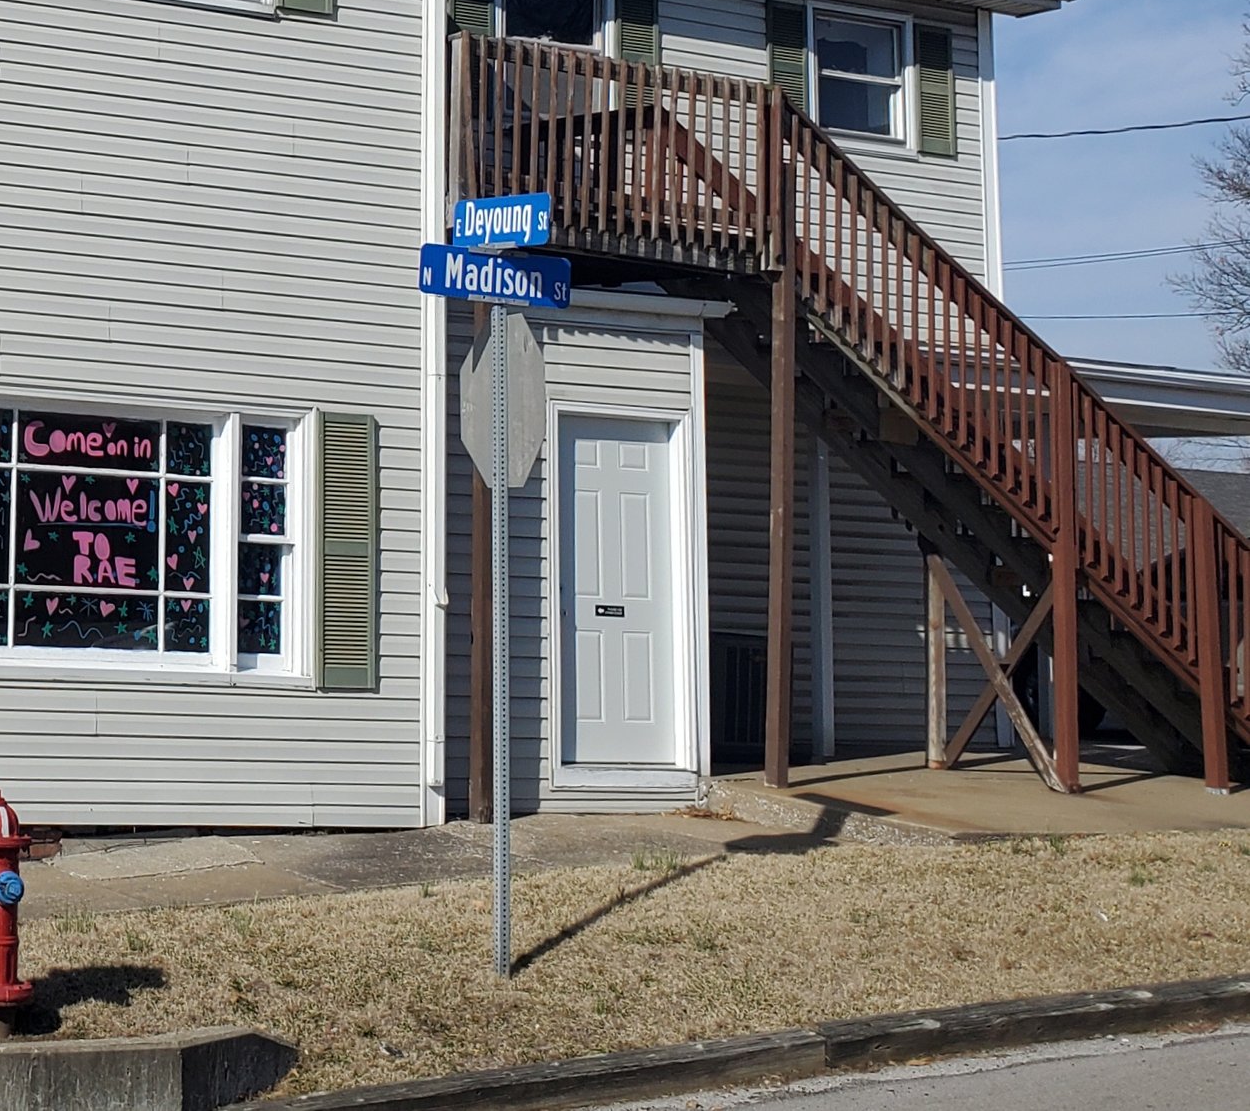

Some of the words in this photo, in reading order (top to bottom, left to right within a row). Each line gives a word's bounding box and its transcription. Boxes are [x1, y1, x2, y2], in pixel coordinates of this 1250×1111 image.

[455, 219, 462, 237] E
[464, 201, 533, 244] Deyoung
[537, 211, 548, 230] St
[422, 266, 432, 286] N
[444, 253, 543, 299] Madison
[553, 281, 567, 302] St
[24, 420, 104, 457] Come
[107, 440, 128, 457] on
[134, 437, 152, 459] in
[29, 487, 156, 533] Welcome!
[72, 530, 111, 560] TO
